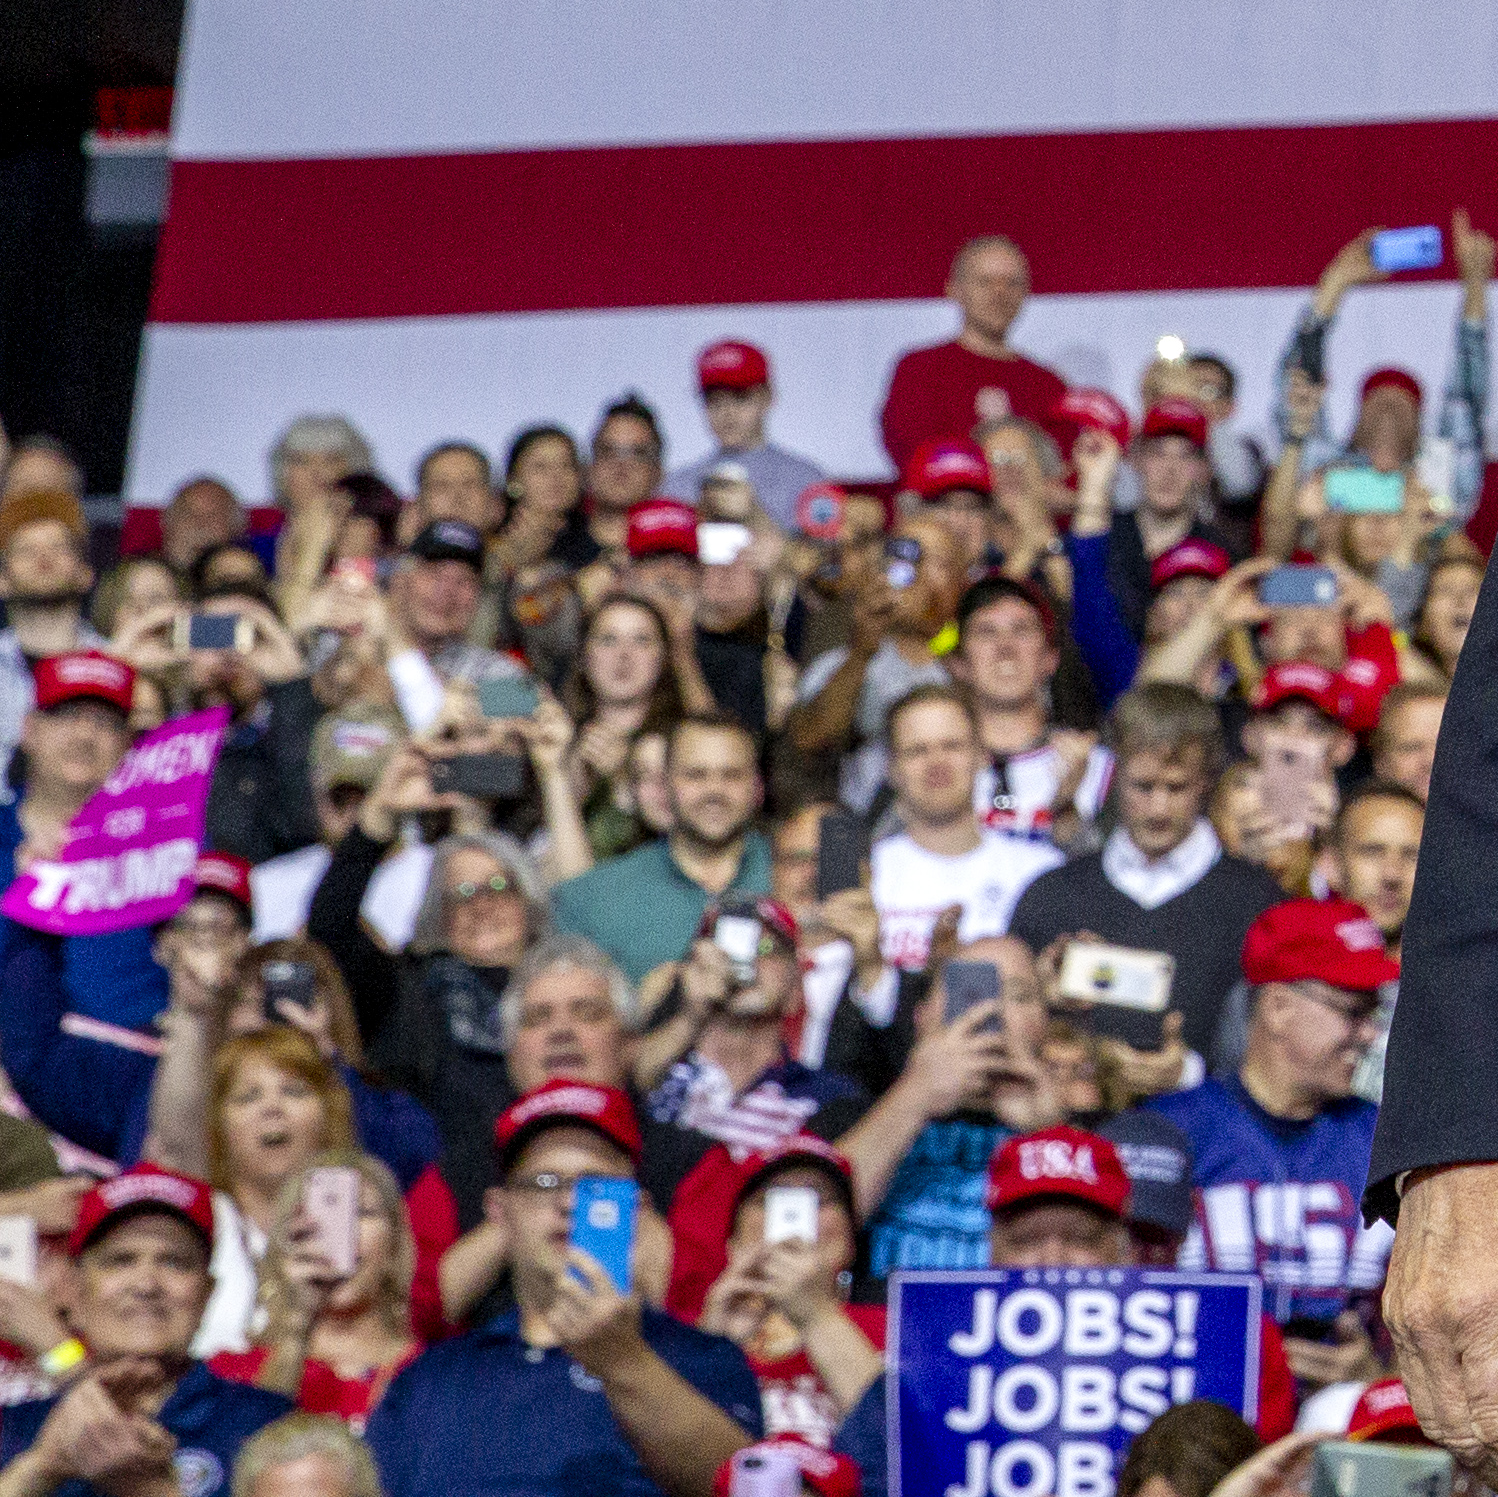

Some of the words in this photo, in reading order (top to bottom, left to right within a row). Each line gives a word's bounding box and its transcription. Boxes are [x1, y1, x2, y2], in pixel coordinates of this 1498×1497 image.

[102, 729, 221, 796] OMEN
[27, 836, 198, 915] TRUMP
[1018, 1138, 1100, 1186] USA
[948, 1287, 1201, 1359] JOBS!
[943, 1363, 1196, 1434] JOBS!
[943, 1439, 1120, 1497] JOB
